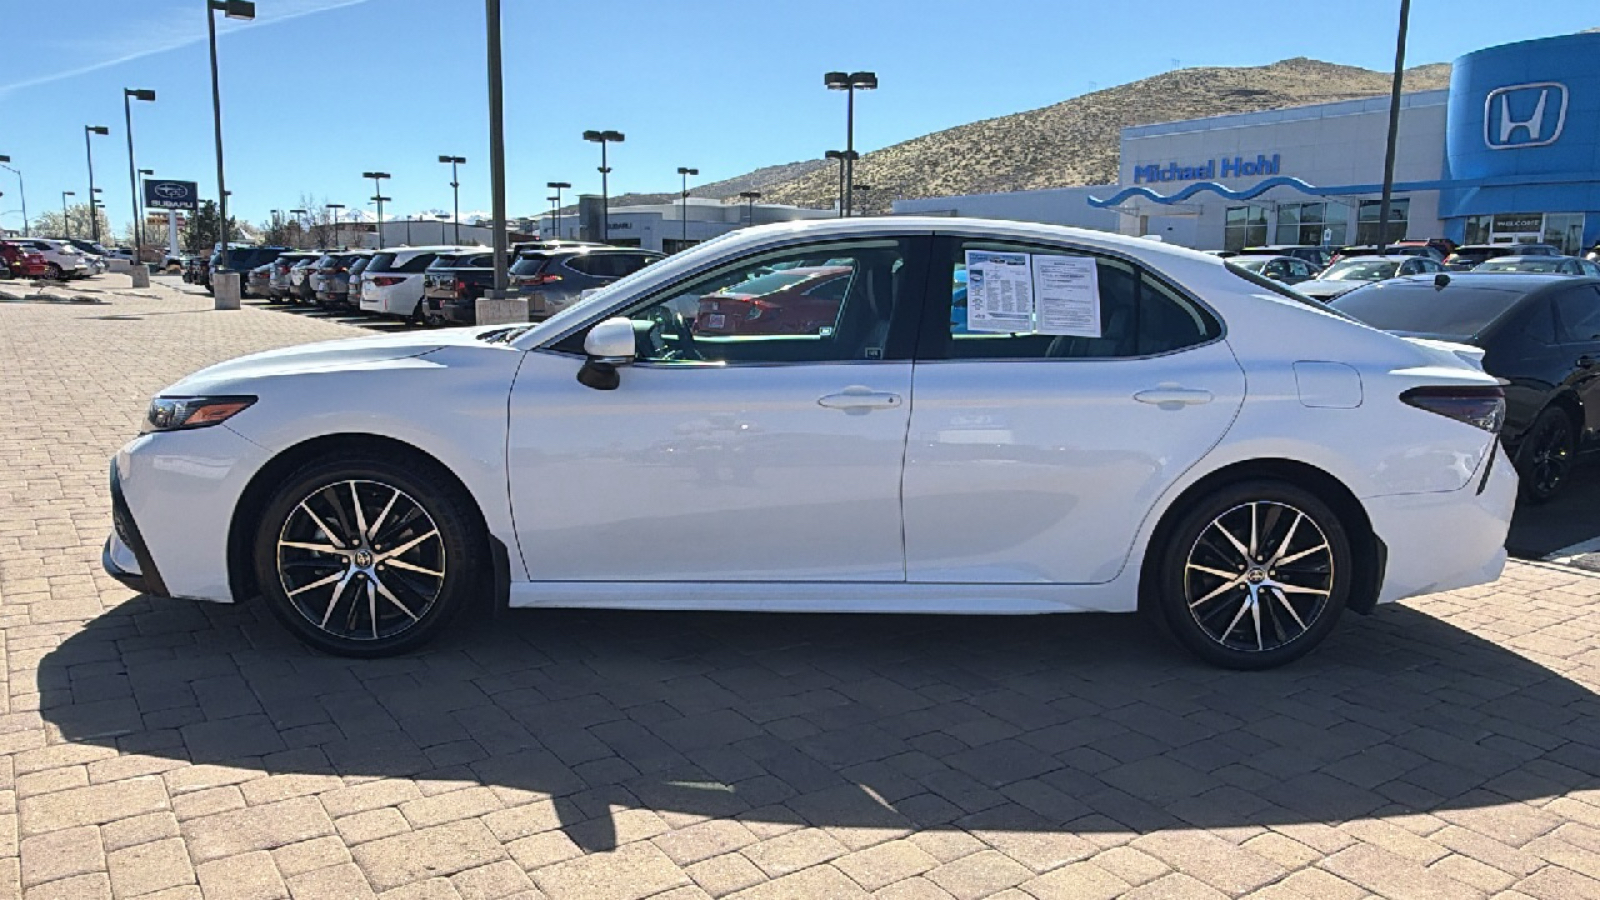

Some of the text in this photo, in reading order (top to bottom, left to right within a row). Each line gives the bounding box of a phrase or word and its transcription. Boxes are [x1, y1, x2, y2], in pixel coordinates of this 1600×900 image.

[1134, 154, 1281, 184] Michael Hohl
[150, 199, 194, 208] SUBARU
[1496, 219, 1540, 227] WELCOME
